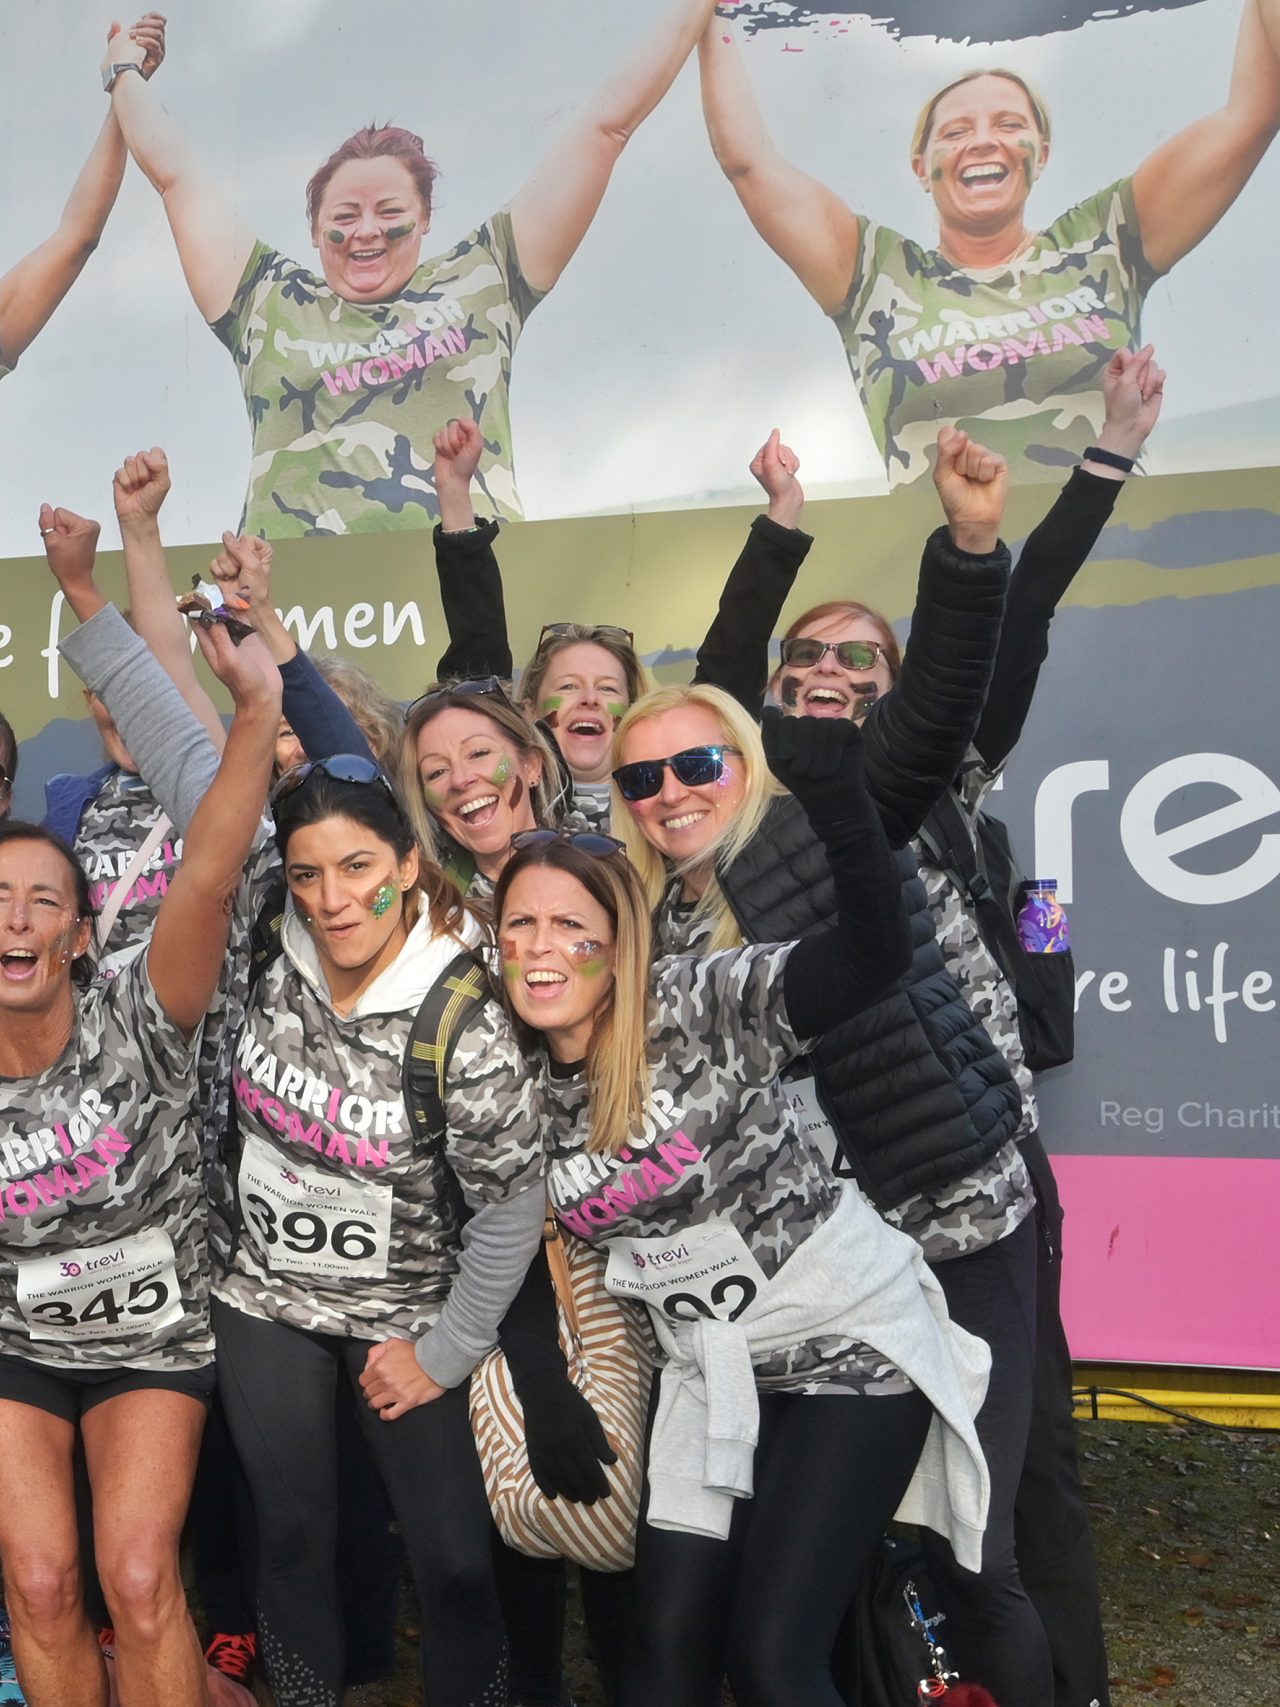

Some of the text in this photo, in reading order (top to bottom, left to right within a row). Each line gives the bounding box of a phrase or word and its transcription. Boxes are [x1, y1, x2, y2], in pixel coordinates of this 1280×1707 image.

[898, 286, 1106, 360] WARRIOR
[320, 324, 468, 397] WOMAN
[916, 314, 1111, 384] WOMAN
[1163, 942, 1276, 1044] life
[236, 1029, 404, 1135] WARRIOR
[235, 1072, 389, 1168] WOMAN
[1101, 1101, 1164, 1133] Reg
[247, 1173, 262, 1187] THE
[263, 1183, 305, 1207] WARRIOR
[306, 1202, 347, 1213] WOMEN
[349, 1208, 378, 1217] WALK
[302, 1179, 341, 1197] trevi
[48, 1283, 94, 1297] WARRIOR
[96, 1270, 135, 1285] WOMEN
[137, 1260, 164, 1273] WALK
[85, 1248, 125, 1271] trevi
[612, 1278, 626, 1288] THE
[668, 1268, 709, 1285] WOMEN
[709, 1255, 740, 1272] WALK
[647, 1244, 689, 1266] trevi
[31, 1270, 169, 1327] 345
